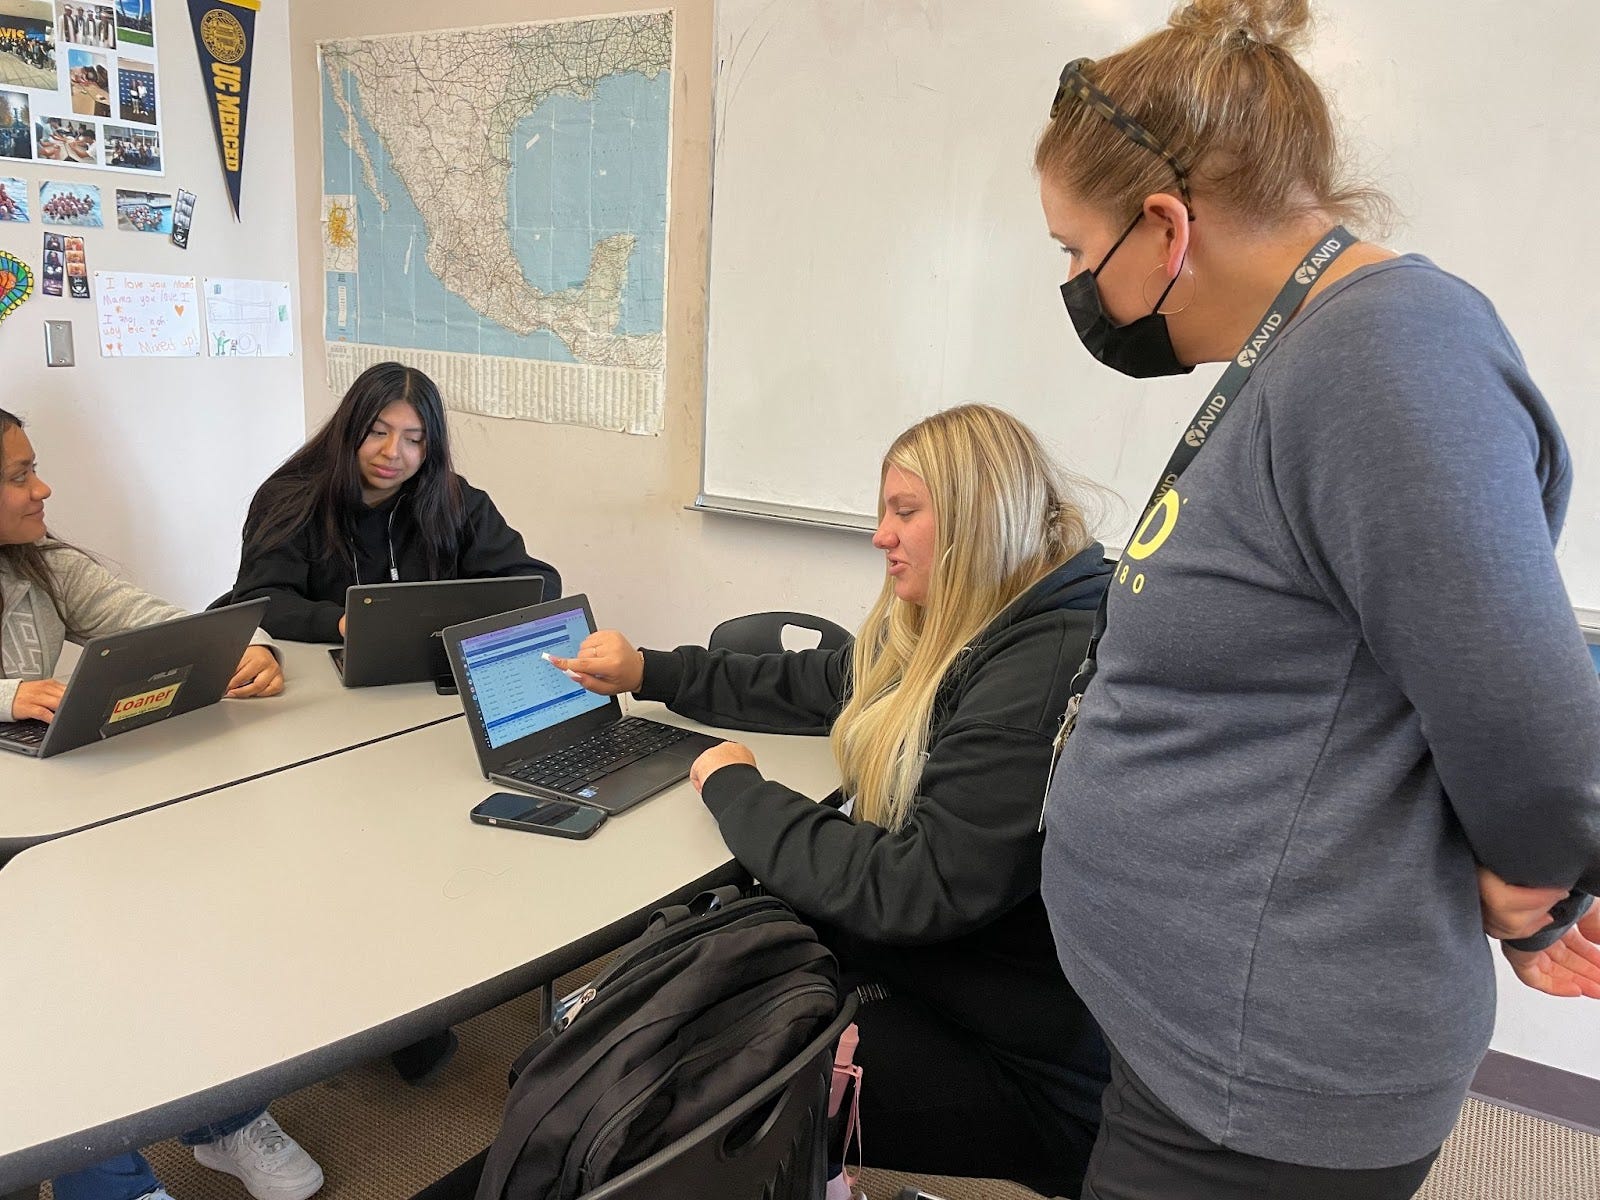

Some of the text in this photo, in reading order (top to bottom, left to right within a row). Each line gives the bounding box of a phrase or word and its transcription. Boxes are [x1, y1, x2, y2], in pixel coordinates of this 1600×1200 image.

[211, 62, 242, 93] UC
[215, 92, 241, 172] MERCED
[1310, 238, 1341, 269] AVID
[1251, 312, 1283, 352] AVID
[1197, 394, 1227, 433] AVID
[113, 688, 174, 714] Loaner
